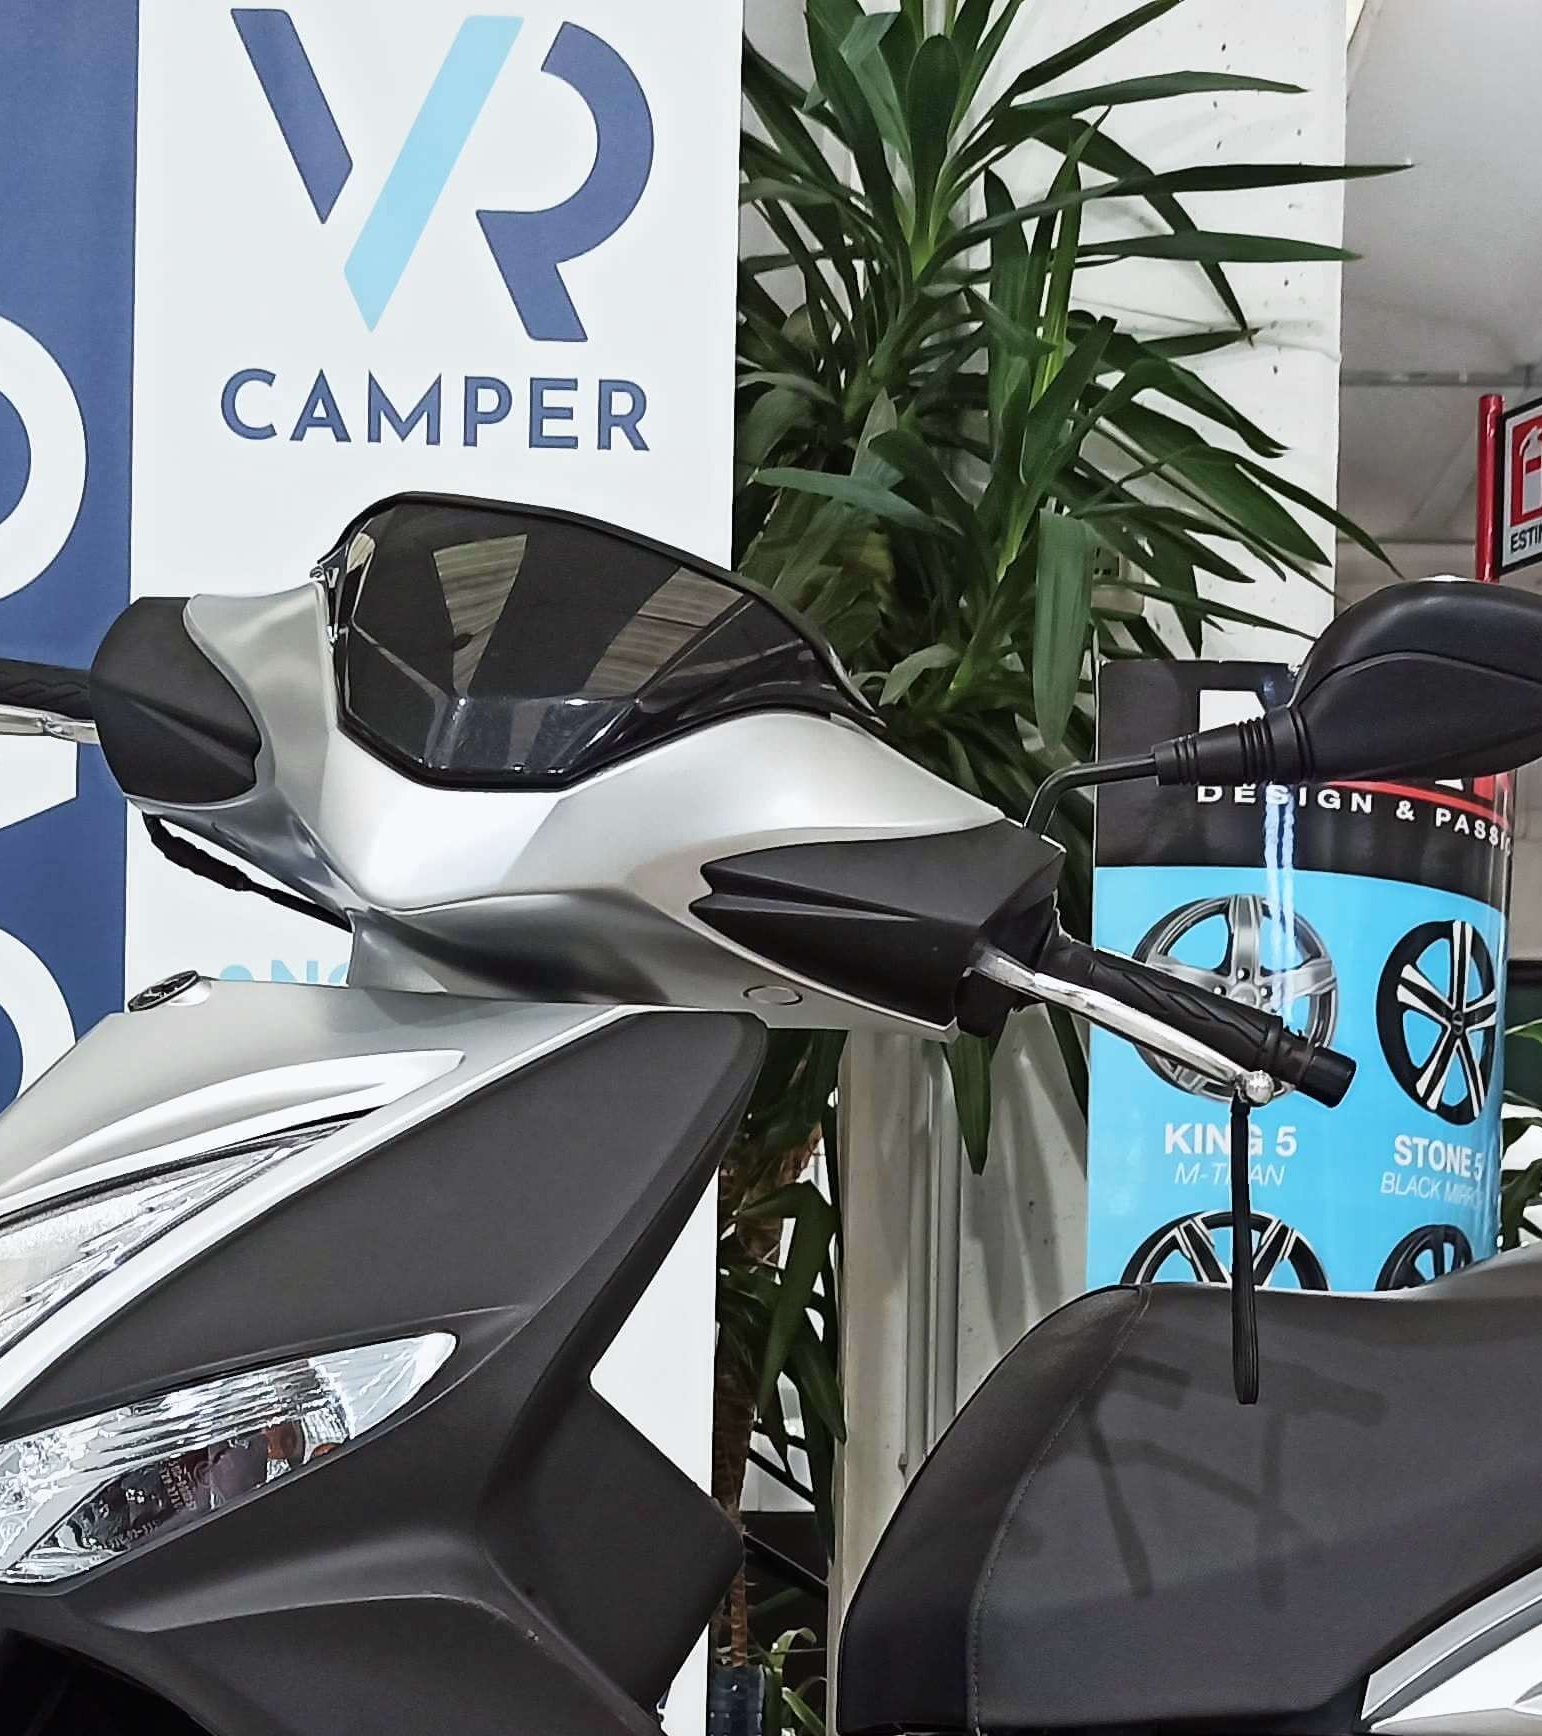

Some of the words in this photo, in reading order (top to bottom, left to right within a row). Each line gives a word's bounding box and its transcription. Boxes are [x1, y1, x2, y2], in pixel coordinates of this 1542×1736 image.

[230, 6, 656, 343] VR
[219, 368, 651, 452] CAMPER
[1197, 783, 1373, 814] DESIGN
[1395, 799, 1416, 822] &
[1275, 1124, 1298, 1158] 5
[1393, 1134, 1472, 1178] STONE
[1380, 1171, 1444, 1200] BLACK
